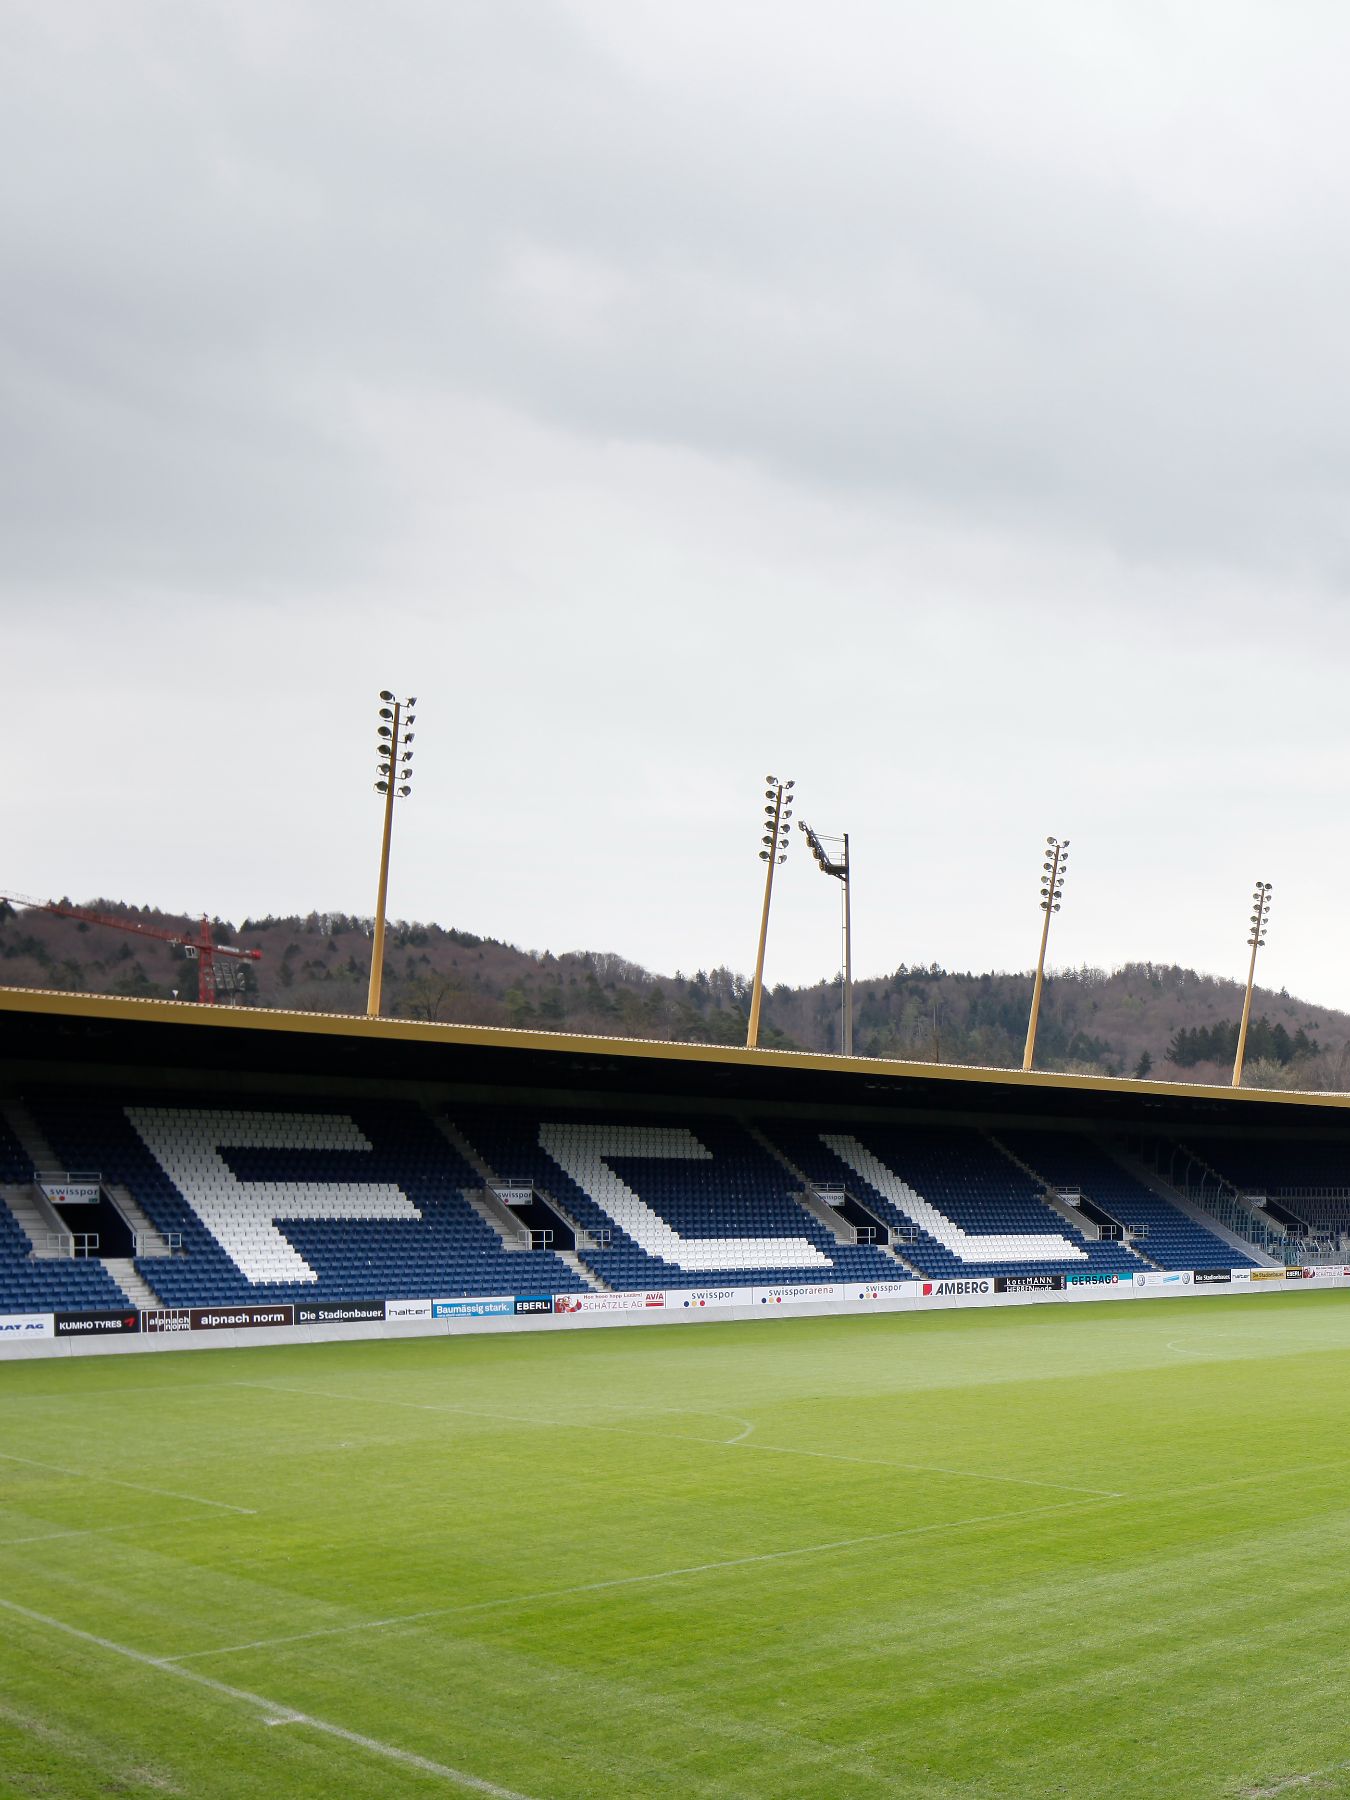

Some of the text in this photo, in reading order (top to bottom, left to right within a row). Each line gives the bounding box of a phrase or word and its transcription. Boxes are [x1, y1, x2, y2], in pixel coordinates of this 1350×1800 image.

[50, 1187, 97, 1198] swisspor
[1072, 1275, 1112, 1286] GERSAG
[768, 1286, 835, 1297] swissporarena
[865, 1284, 903, 1294] swisspor
[935, 1280, 989, 1296] AMBERG
[645, 1292, 665, 1301] AVIA
[691, 1290, 735, 1301] swisspor
[436, 1302, 511, 1315] Baumässig stark.
[516, 1300, 551, 1311] EBERLI
[583, 1299, 629, 1311] SCHÄTZLE
[300, 1308, 384, 1320] Die Stadionbauer.
[388, 1308, 431, 1316] halter
[149, 1316, 190, 1326] alpnach
[200, 1312, 285, 1326] alpnach norm
[59, 1319, 122, 1331] KUMHO TYRES
[165, 1323, 190, 1331] norm
